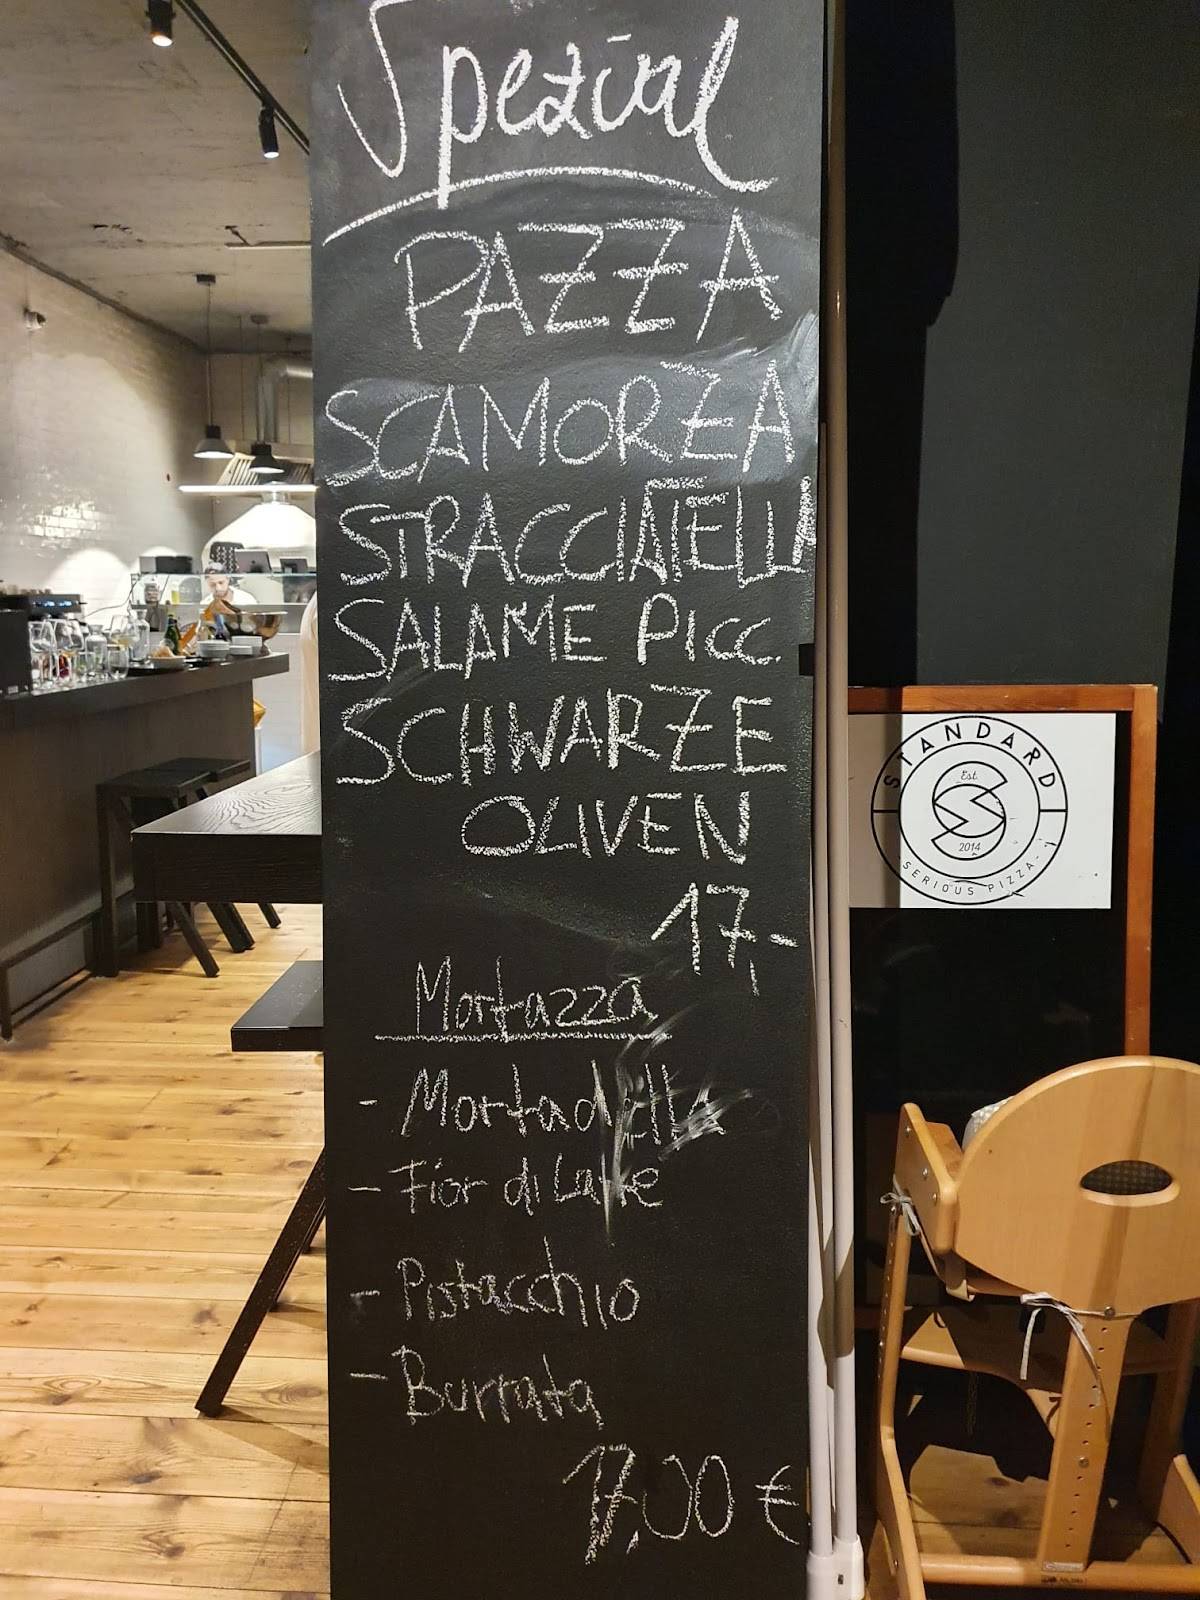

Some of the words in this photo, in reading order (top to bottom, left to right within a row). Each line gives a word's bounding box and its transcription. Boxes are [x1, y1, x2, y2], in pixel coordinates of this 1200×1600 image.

[338, 0, 778, 210] Spezial
[394, 208, 784, 353] PAZZA
[324, 359, 797, 487] SCAMORZA
[328, 595, 607, 682] SALAME
[336, 683, 789, 787] SCHWARZE
[883, 721, 1056, 789] STANDARD
[461, 791, 750, 865] OLIVEN
[958, 842, 981, 852] 2014
[902, 861, 975, 896] SERIOUS
[987, 861, 1035, 893] PIZZA
[415, 955, 658, 1040] Mortazza
[388, 1158, 489, 1214] Fior
[504, 1156, 540, 1217] di
[397, 1236, 641, 1330] Pistacchio
[391, 1344, 604, 1430] Burrata
